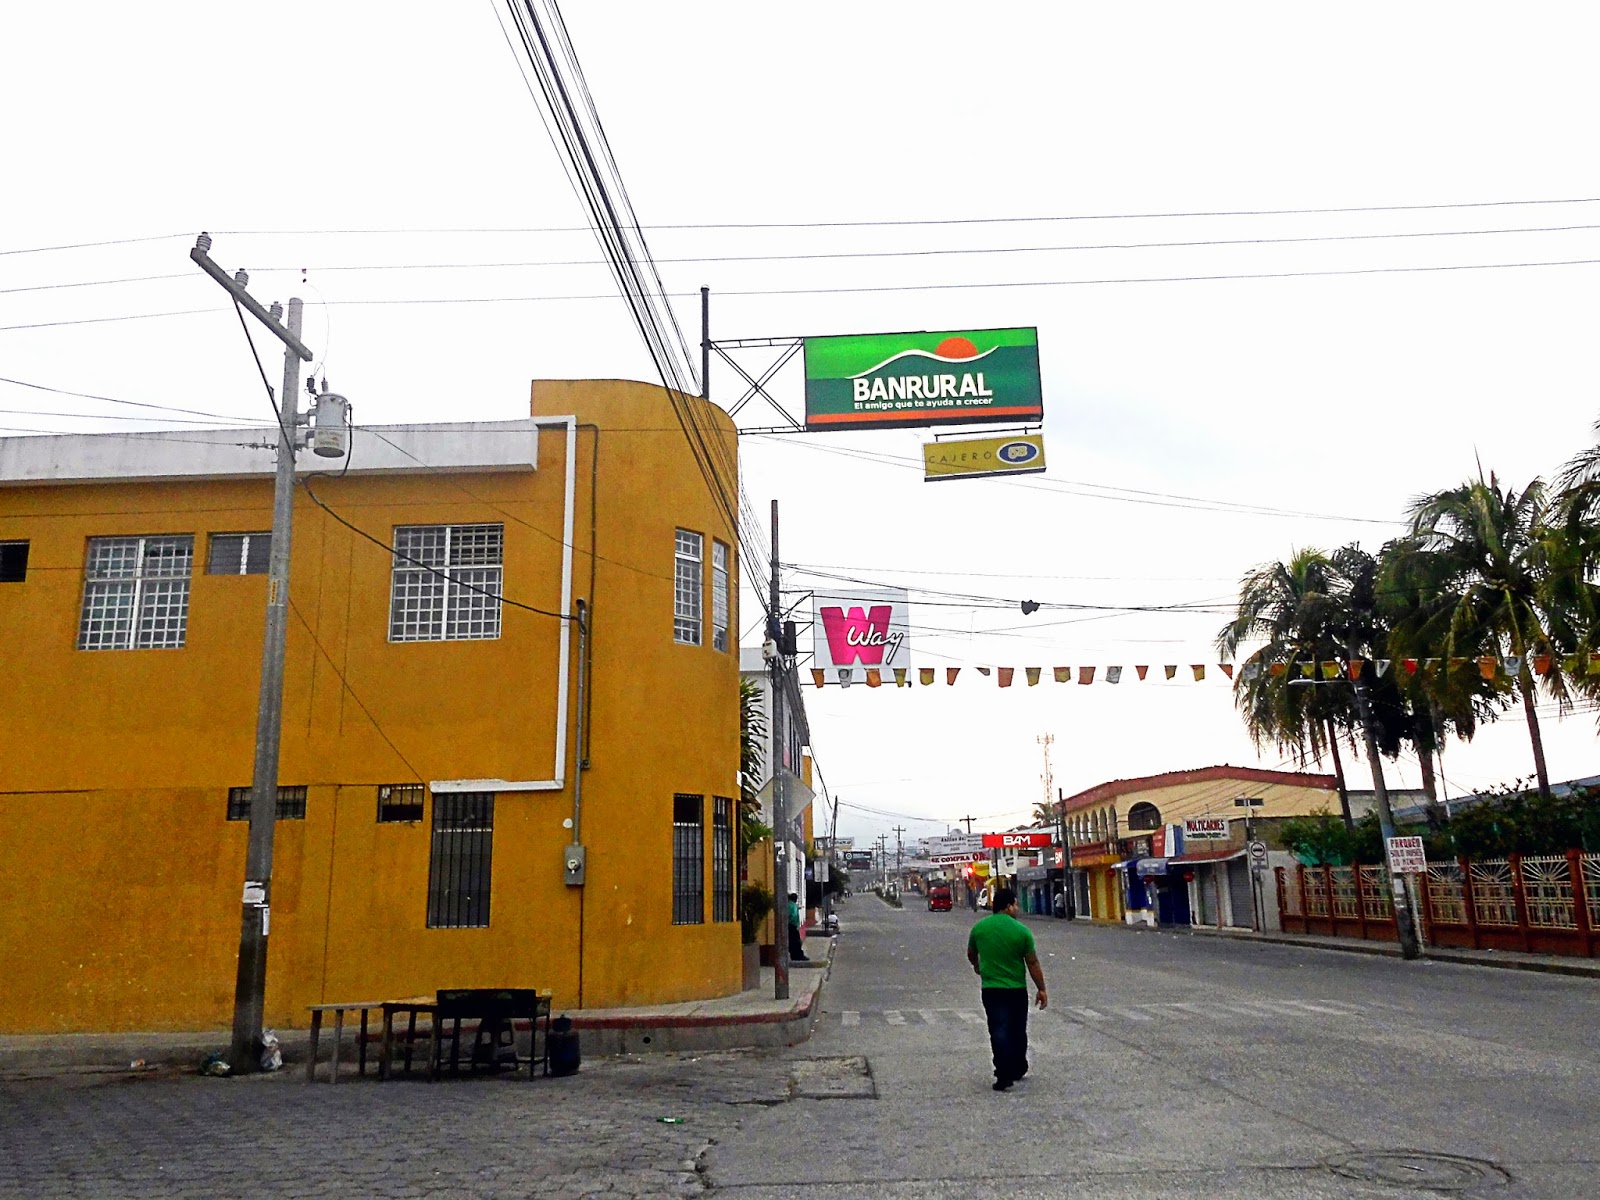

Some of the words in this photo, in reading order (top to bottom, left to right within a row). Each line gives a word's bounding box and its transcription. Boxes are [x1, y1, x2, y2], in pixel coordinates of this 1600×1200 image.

[853, 372, 993, 402] BANRURAL
[854, 402, 863, 410] El
[864, 401, 893, 411] amigo
[895, 401, 912, 409] que
[926, 398, 954, 408] ayuda
[964, 398, 993, 406] crecer
[928, 451, 992, 464] CAJERO
[847, 622, 904, 666] Way
[1003, 835, 1031, 846] BAM
[941, 855, 970, 863] COMPRA
